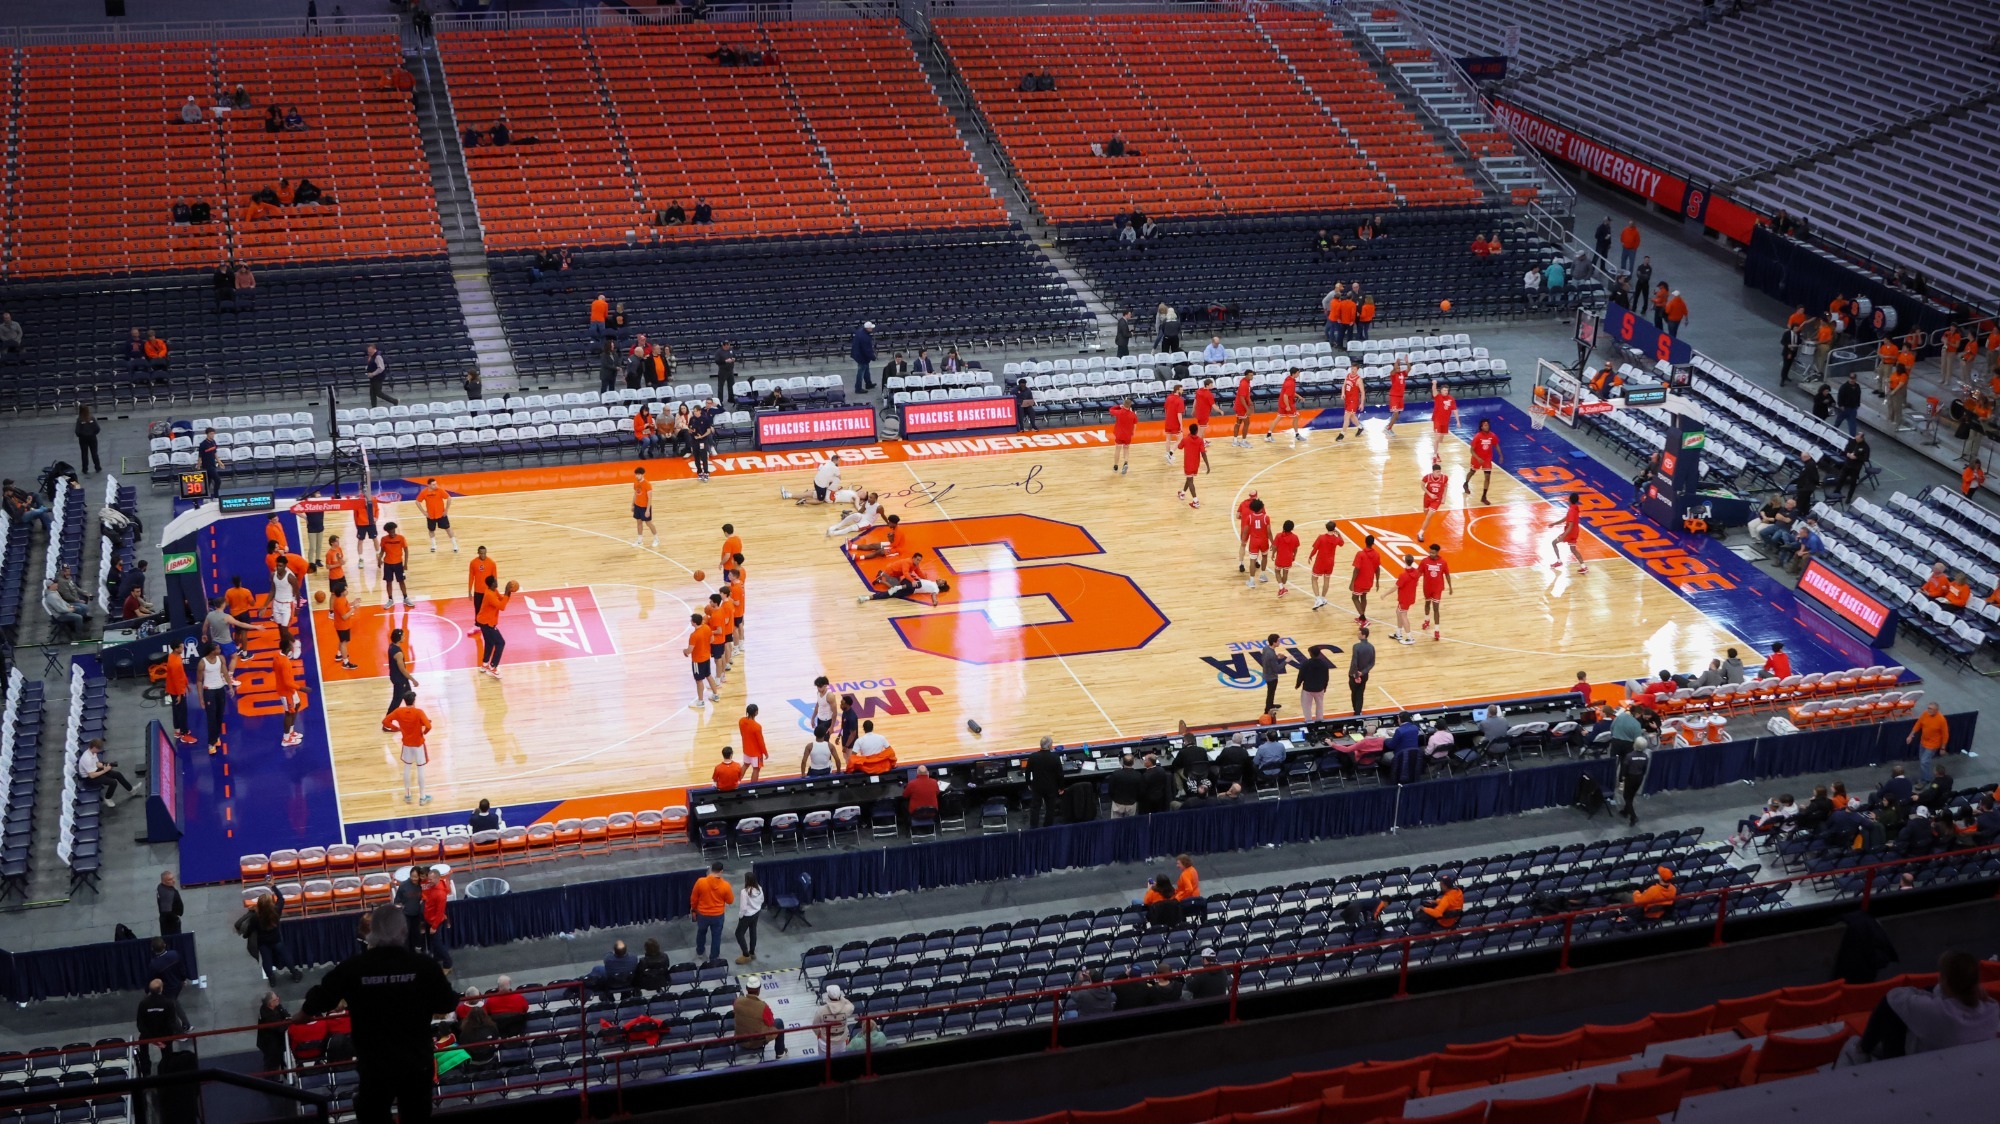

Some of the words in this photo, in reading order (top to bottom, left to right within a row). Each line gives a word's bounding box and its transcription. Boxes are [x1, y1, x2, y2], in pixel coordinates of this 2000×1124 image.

[1495, 105, 1567, 155] SYRACUSE
[1568, 137, 1662, 198] UNIVERSITY
[1686, 190, 1704, 219] S
[1621, 311, 1636, 341] S
[1656, 333, 1671, 361] S
[763, 421, 811, 437] SYRACUSE
[813, 417, 871, 433] BASKETBALL
[909, 411, 955, 425] SYRACUSE
[957, 407, 1012, 421] BASKETBALL
[688, 446, 890, 474] SYRACUSE
[901, 429, 1109, 457] UNIVERSITY
[182, 473, 204, 483] 47:52
[187, 483, 202, 494] 30
[1657, 472, 1673, 486] TOYOTA
[1656, 492, 1673, 508] TOYOTA
[1254, 519, 1262, 529] 11
[1517, 465, 1738, 595] SYRACUSE
[165, 557, 193, 573] LIBMAN
[840, 512, 1172, 666] S
[1804, 569, 1842, 600] SYRACUSE
[1838, 591, 1884, 629] BASKETBALL
[523, 595, 581, 650] ACC
[361, 976, 388, 985] EVENT
[389, 973, 417, 983] STAFF
